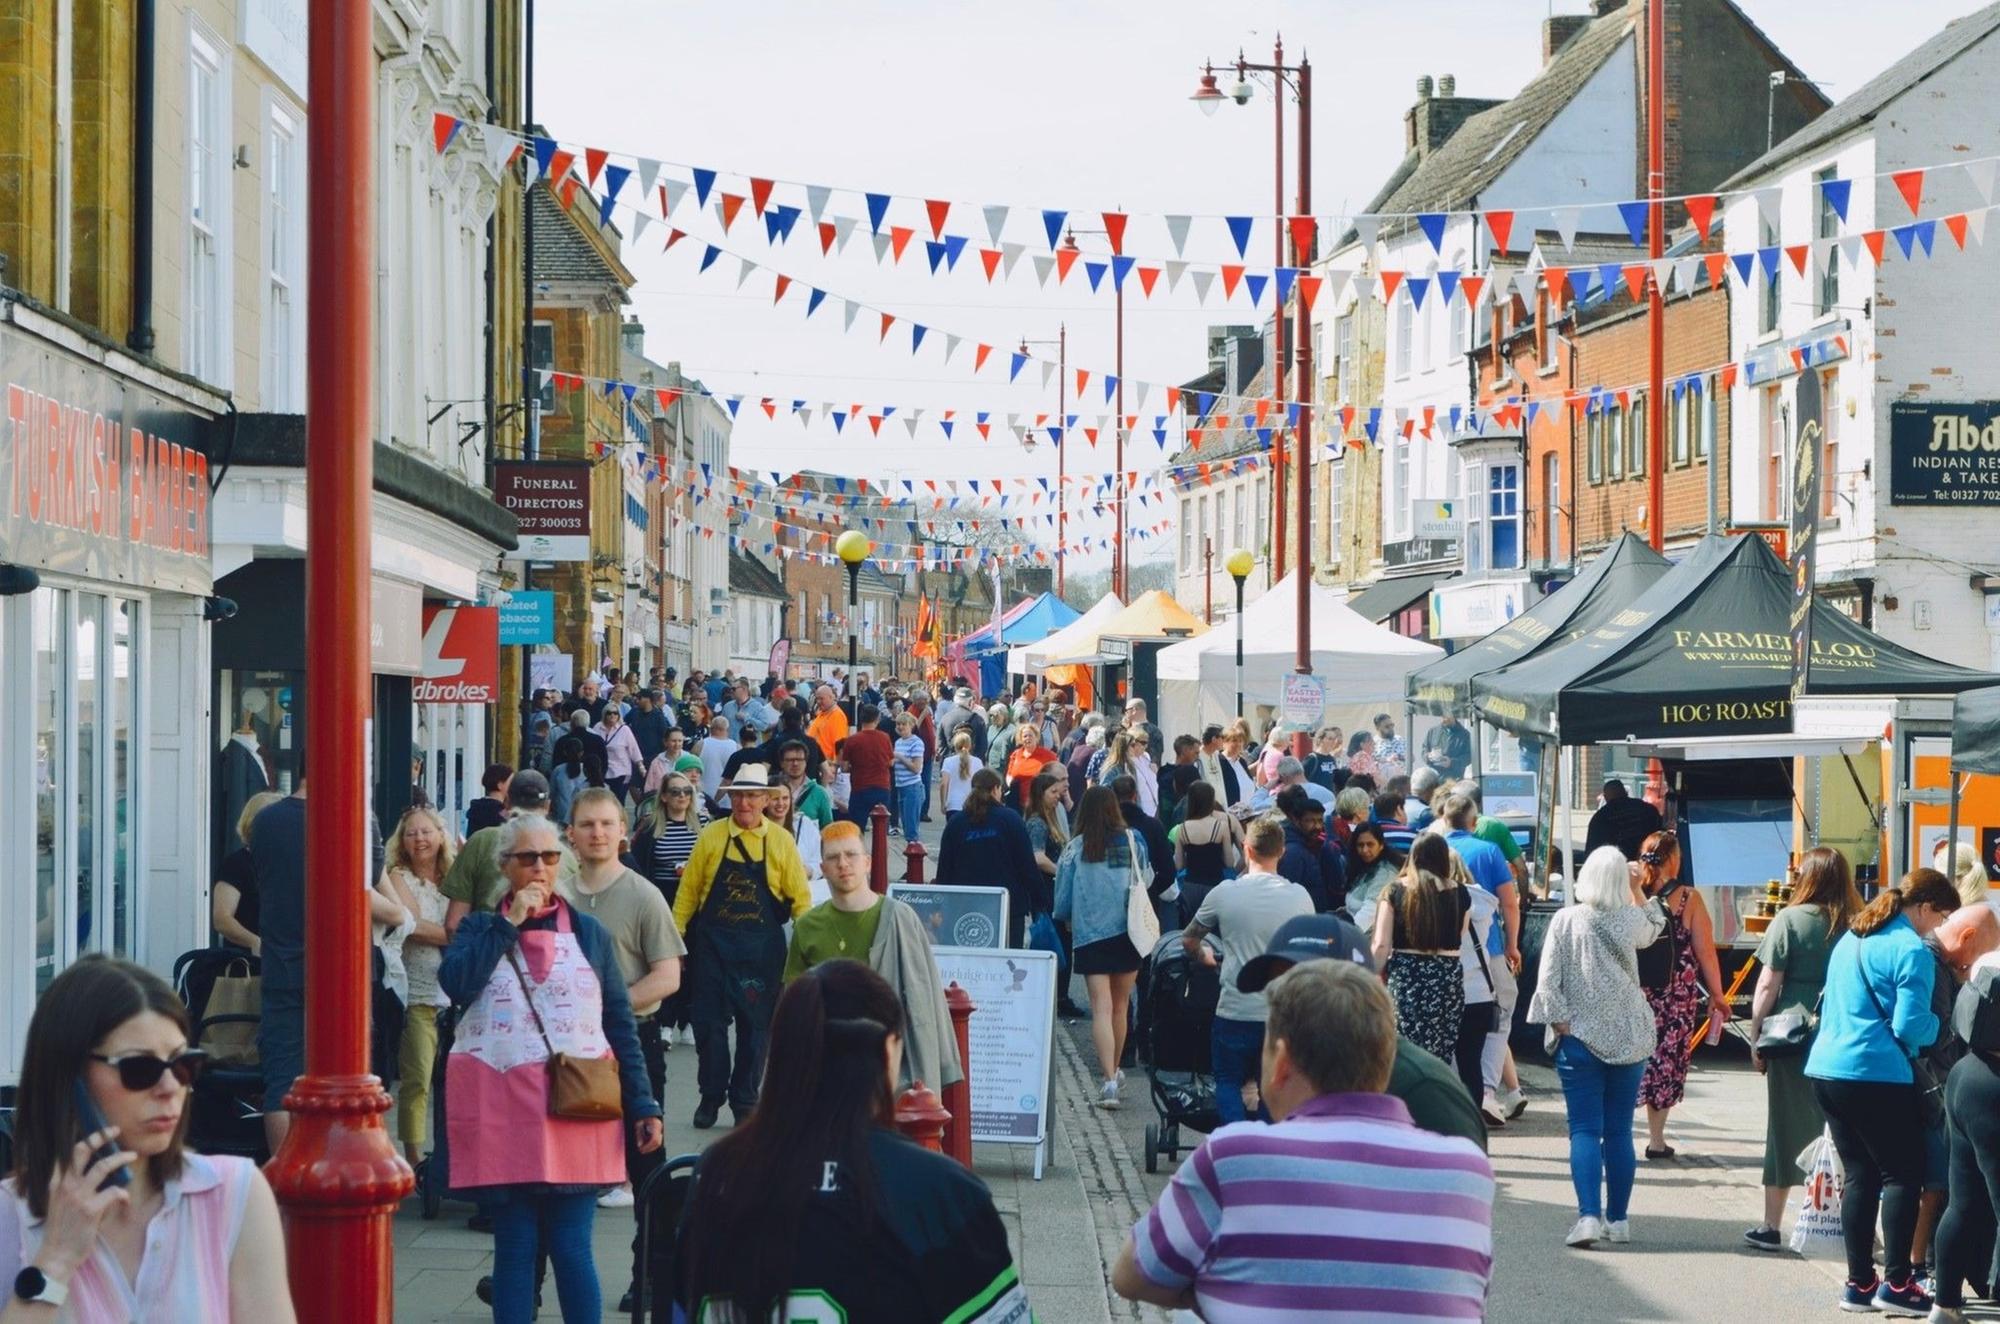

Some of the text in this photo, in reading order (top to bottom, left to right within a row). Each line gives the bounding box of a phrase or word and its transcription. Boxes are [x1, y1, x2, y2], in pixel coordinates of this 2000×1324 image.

[1912, 456, 1971, 469] INDIAN
[8, 383, 208, 560] TURKISH BARBER
[1942, 472, 1999, 484] & TAKE
[1951, 490, 1980, 500] 01327
[516, 517, 582, 529] 327 300033
[1422, 520, 1464, 532] stonhill
[499, 614, 541, 624] obacco
[412, 680, 490, 700] dbrokes
[1662, 700, 1791, 724] HOG ROAST
